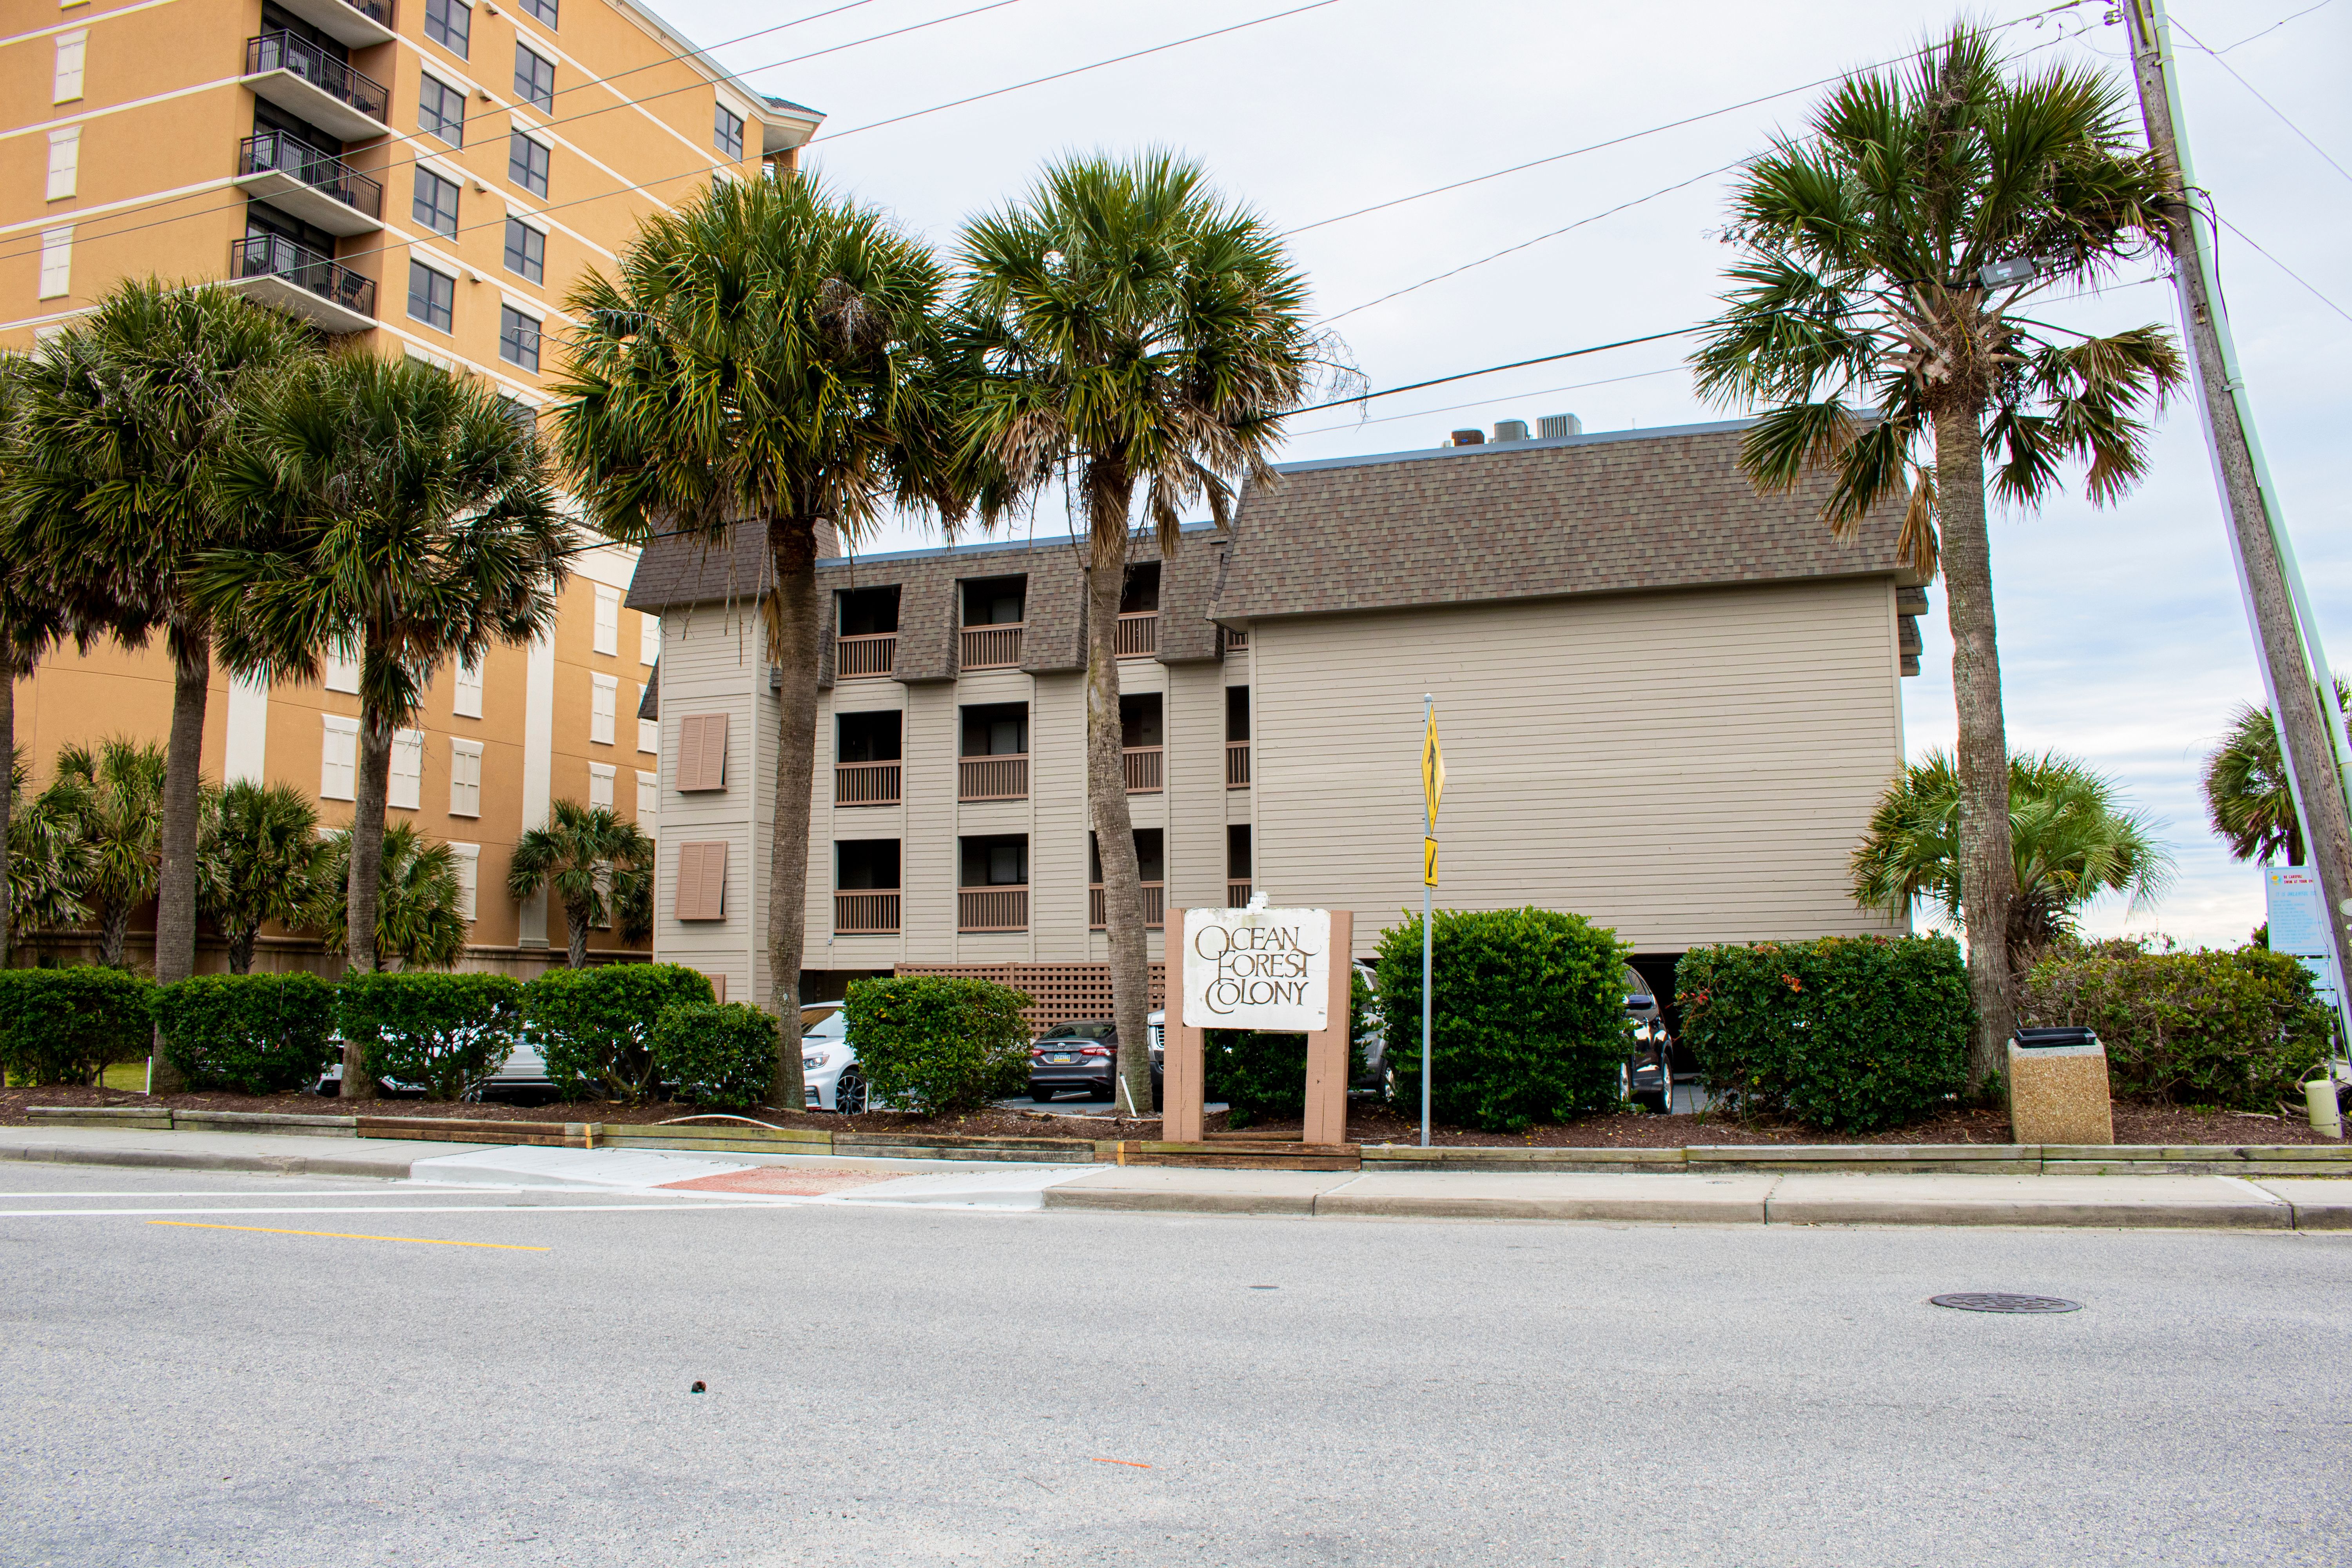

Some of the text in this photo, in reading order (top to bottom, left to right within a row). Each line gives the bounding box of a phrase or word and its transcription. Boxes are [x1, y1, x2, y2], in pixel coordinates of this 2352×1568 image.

[1195, 926, 1321, 960] OCEAN
[1215, 950, 1312, 985] FOREST
[1205, 978, 1310, 1014] COLONY
